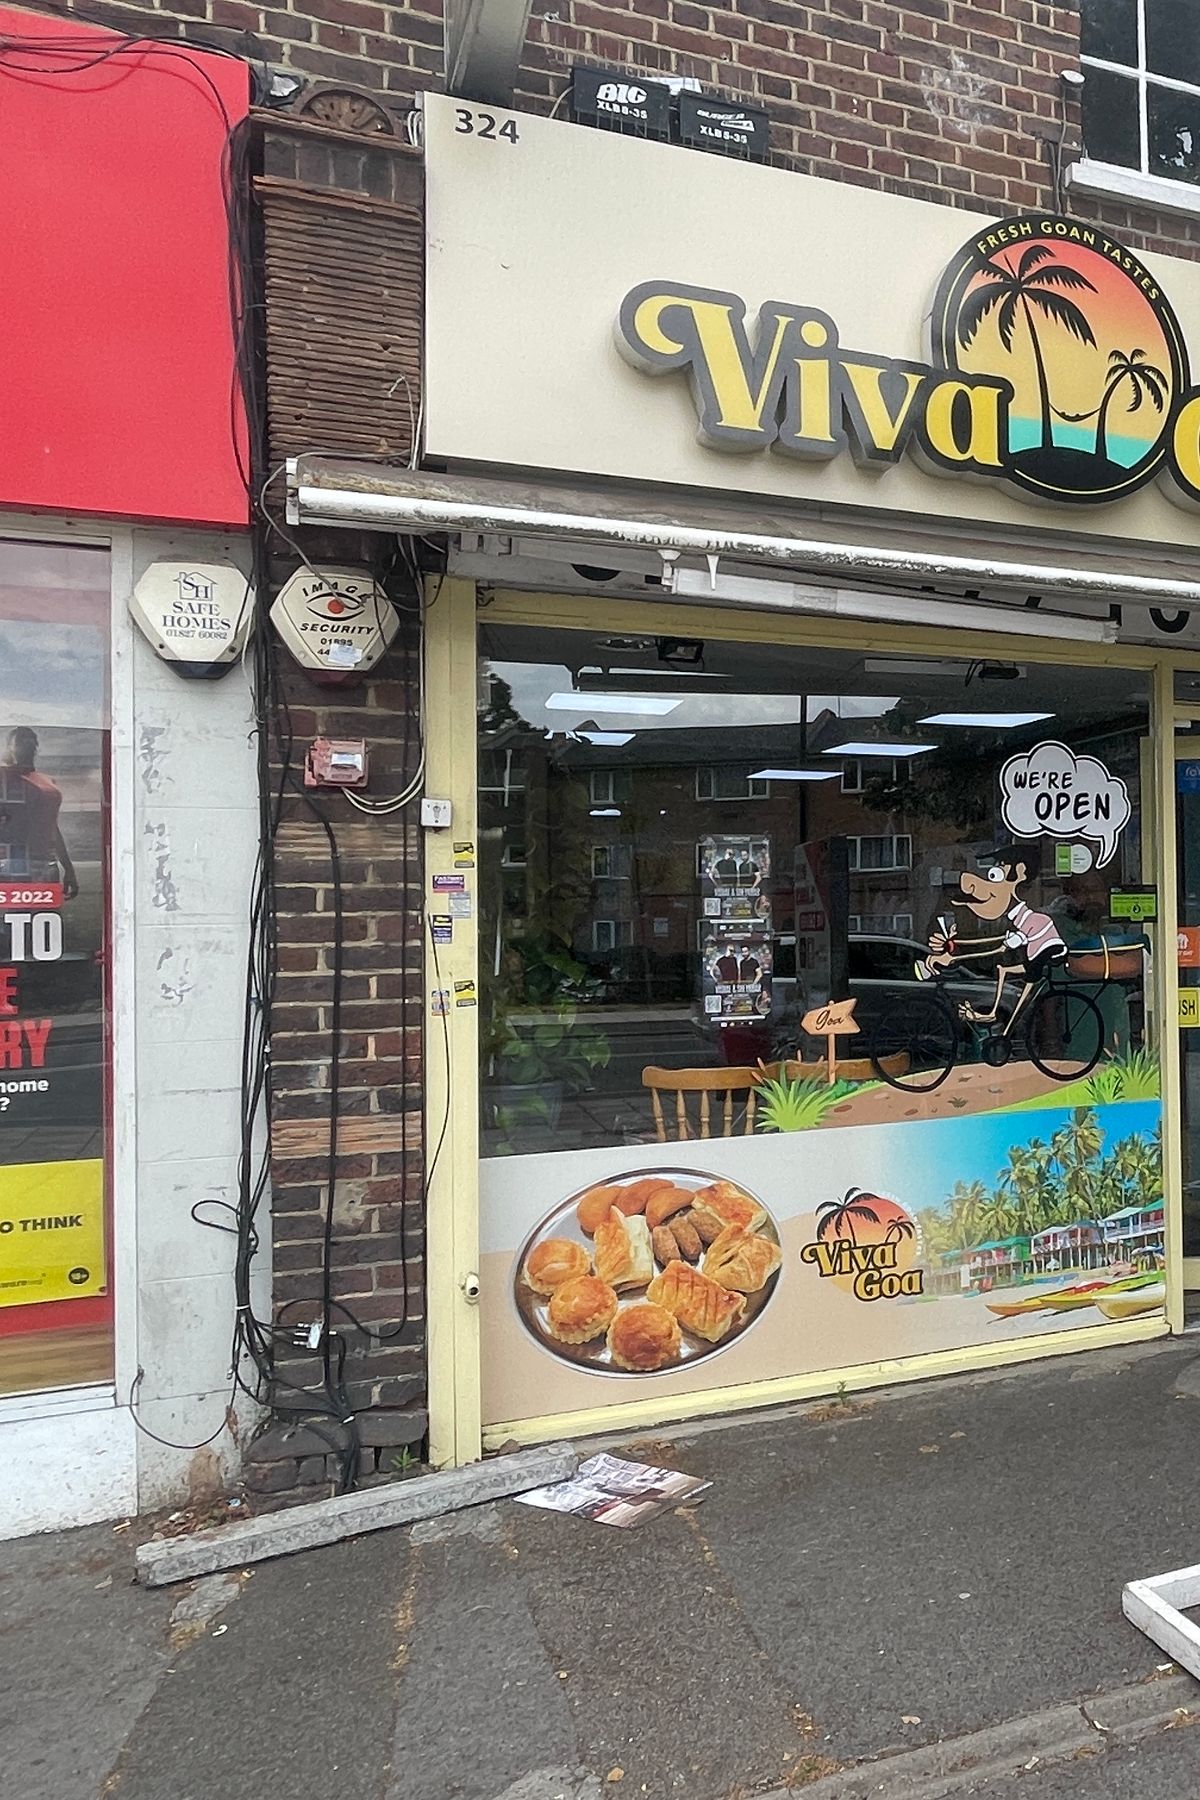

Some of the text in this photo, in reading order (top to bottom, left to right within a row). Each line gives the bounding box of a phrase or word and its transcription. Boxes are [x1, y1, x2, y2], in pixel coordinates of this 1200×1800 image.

[596, 83, 648, 105] BIG
[453, 108, 520, 144] 324
[977, 220, 1160, 301] FRESH GOAN TASTES
[628, 290, 1004, 470] Viva
[172, 601, 221, 616] SAFE
[162, 615, 232, 632] HOMES
[299, 622, 374, 635] SECURITY
[1013, 771, 1074, 790] WE'RE
[1034, 792, 1110, 820] OPEN
[10, 890, 54, 903] 2022
[4, 913, 62, 962] TO
[18, 1214, 85, 1232] THINK
[801, 1238, 900, 1279] Viva
[853, 1269, 924, 1303] Goa
